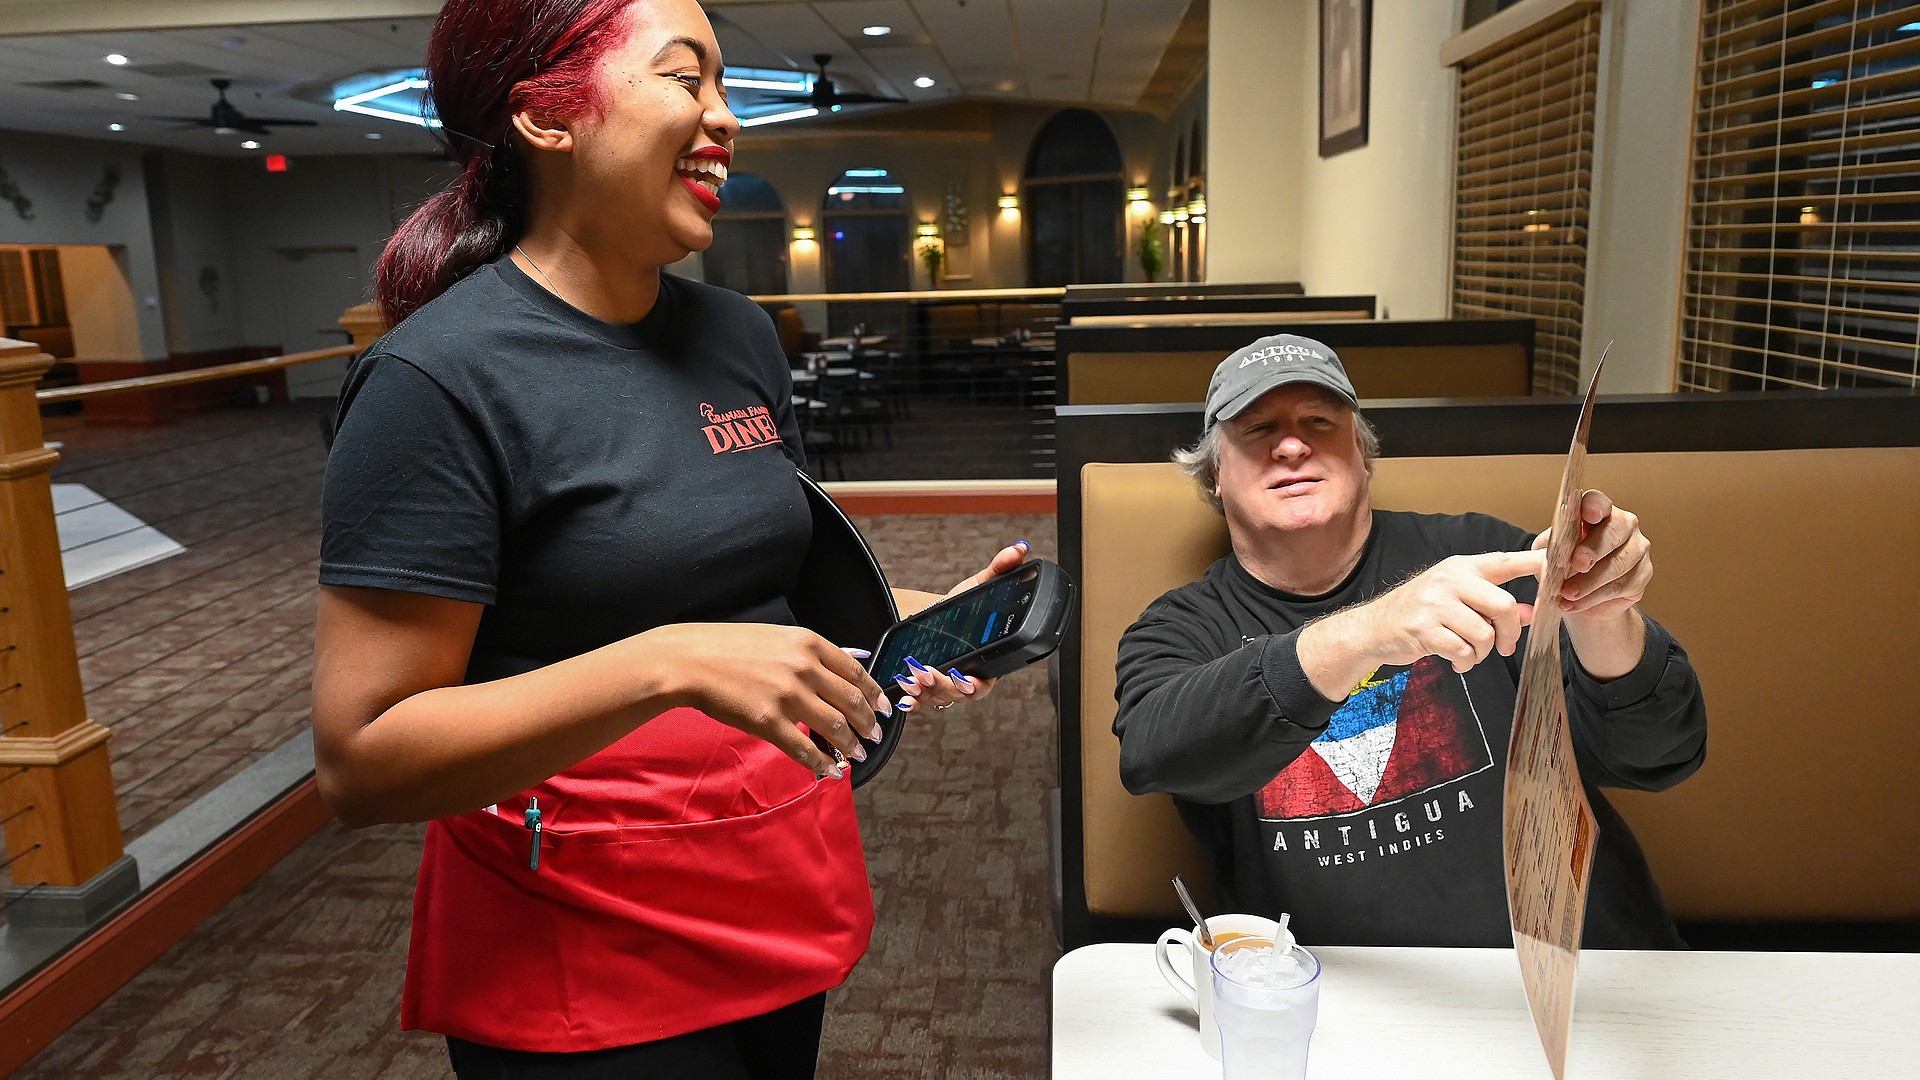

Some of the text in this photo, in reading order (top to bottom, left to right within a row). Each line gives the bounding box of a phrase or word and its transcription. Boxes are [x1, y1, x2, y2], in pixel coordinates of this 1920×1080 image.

[1239, 344, 1324, 369] ANTIGUA
[1262, 355, 1306, 366] 1981
[707, 409, 749, 424] GRANADA
[701, 414, 780, 455] DINE
[1273, 789, 1475, 851] ANTIGUA
[1317, 829, 1446, 867] WEST INDIES
